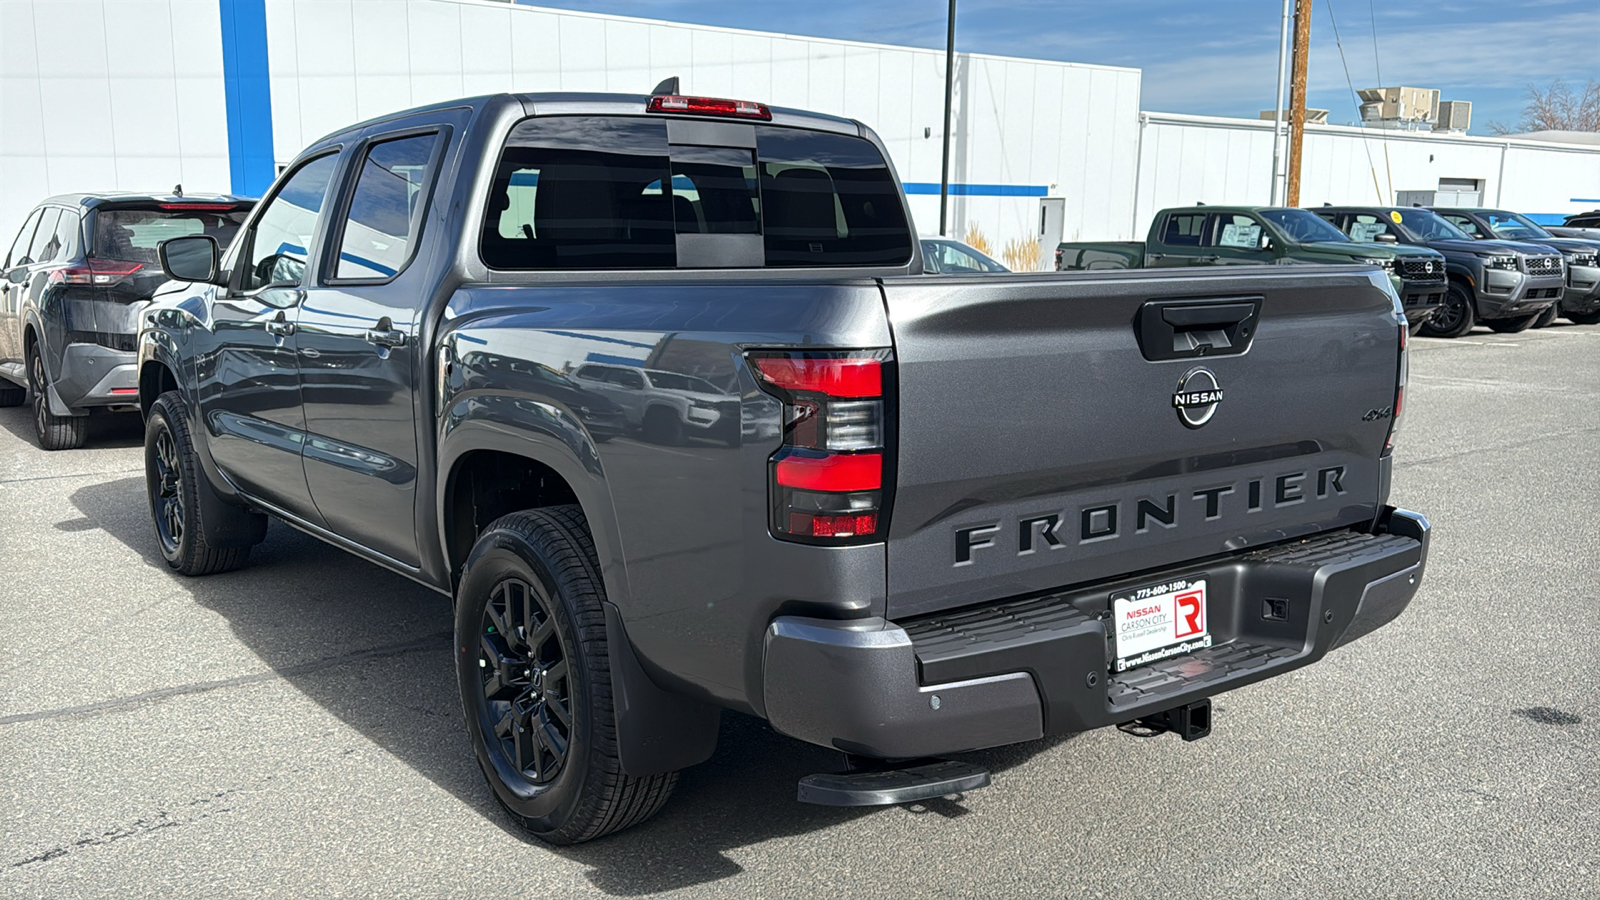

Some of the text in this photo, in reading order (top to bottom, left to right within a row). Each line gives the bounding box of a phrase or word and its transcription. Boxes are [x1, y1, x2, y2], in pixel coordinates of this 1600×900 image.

[1174, 390, 1224, 405] NISSAN
[952, 465, 1348, 568] FRONTIER
[1137, 581, 1186, 599] 775-600-1500
[1127, 605, 1161, 619] NISSAN
[1178, 596, 1200, 633] R
[1122, 614, 1167, 631] CARSON CITY
[1122, 633, 1133, 641] Chris
[1147, 626, 1167, 636] Dealership
[1126, 641, 1204, 667] www.NissanCarsonCity.com
